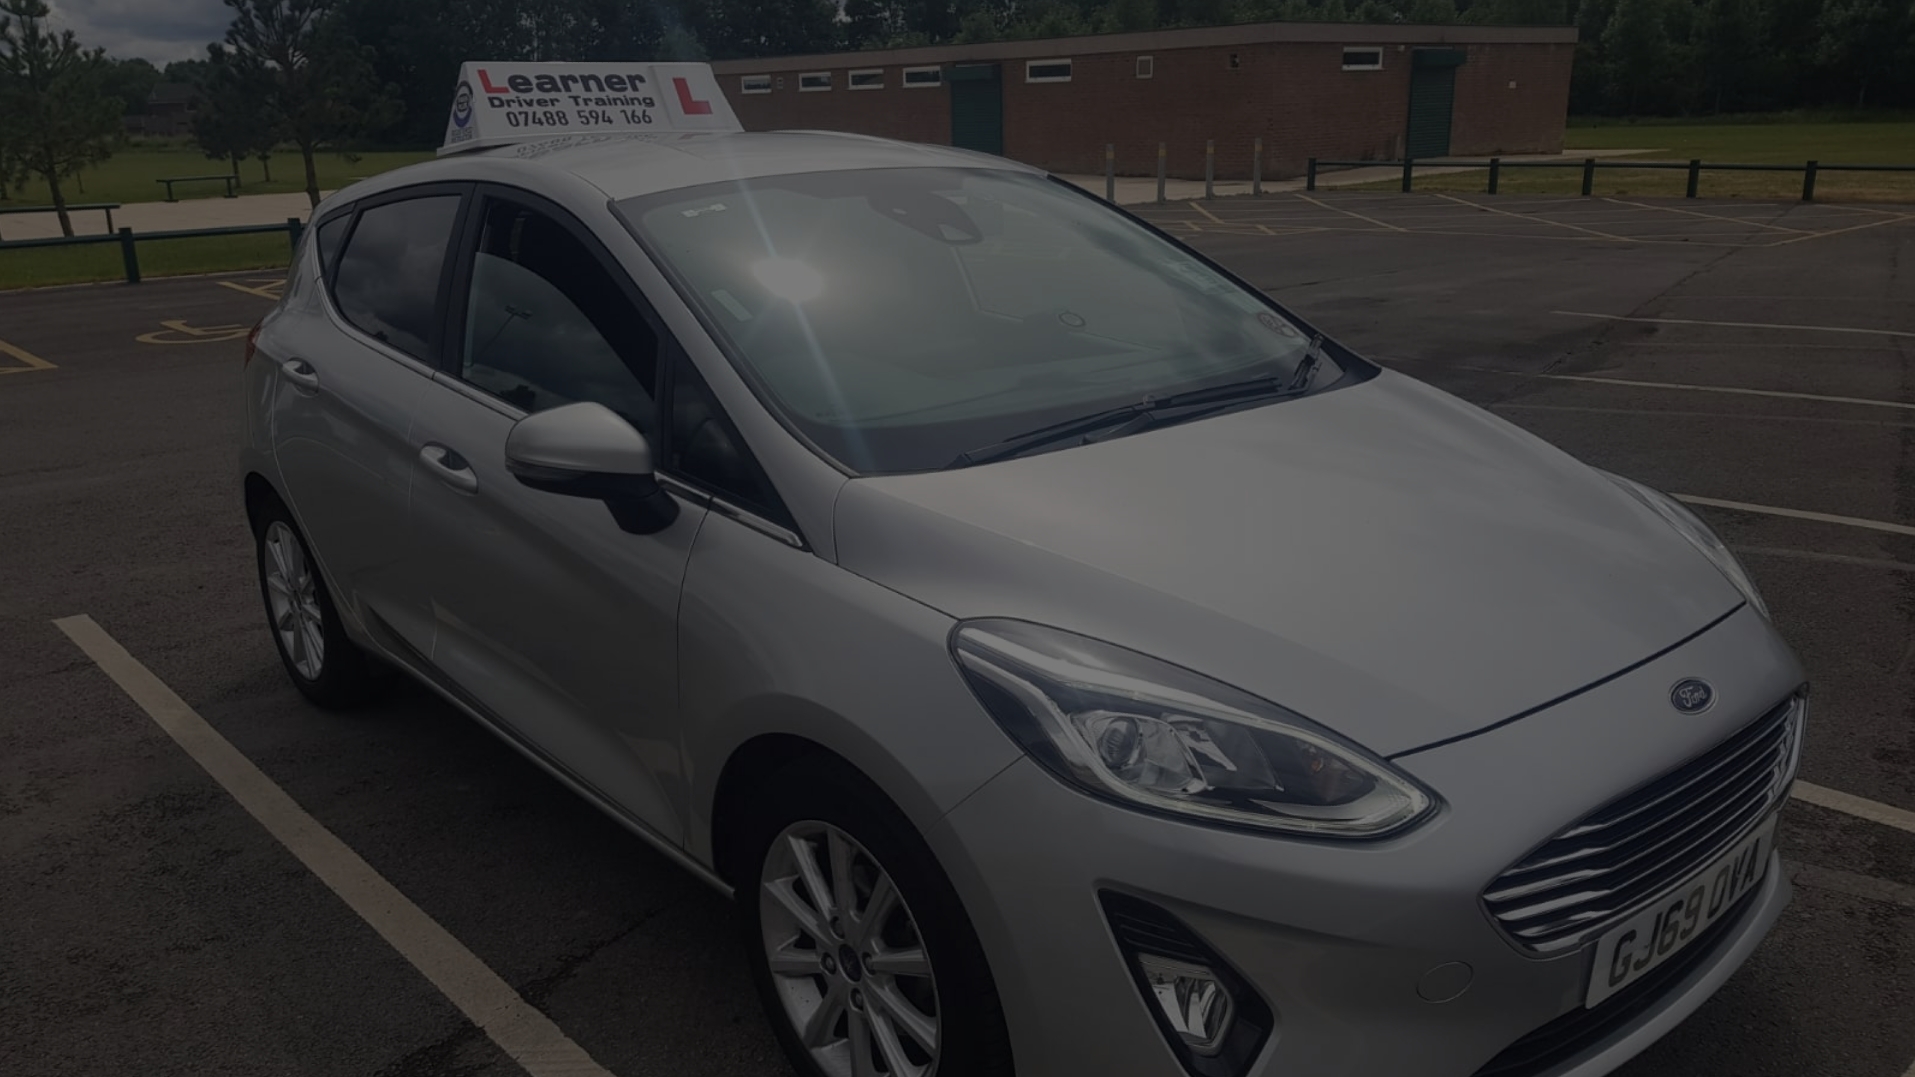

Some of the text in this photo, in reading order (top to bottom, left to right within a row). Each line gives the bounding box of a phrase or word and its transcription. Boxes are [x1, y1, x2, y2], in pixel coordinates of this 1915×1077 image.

[477, 69, 646, 94] Learner
[487, 93, 655, 109] Driver Training
[672, 77, 713, 115] L
[506, 108, 652, 128] 07488 594 166
[1678, 685, 1708, 708] Ford
[1608, 837, 1760, 987] GJ69 OVA
